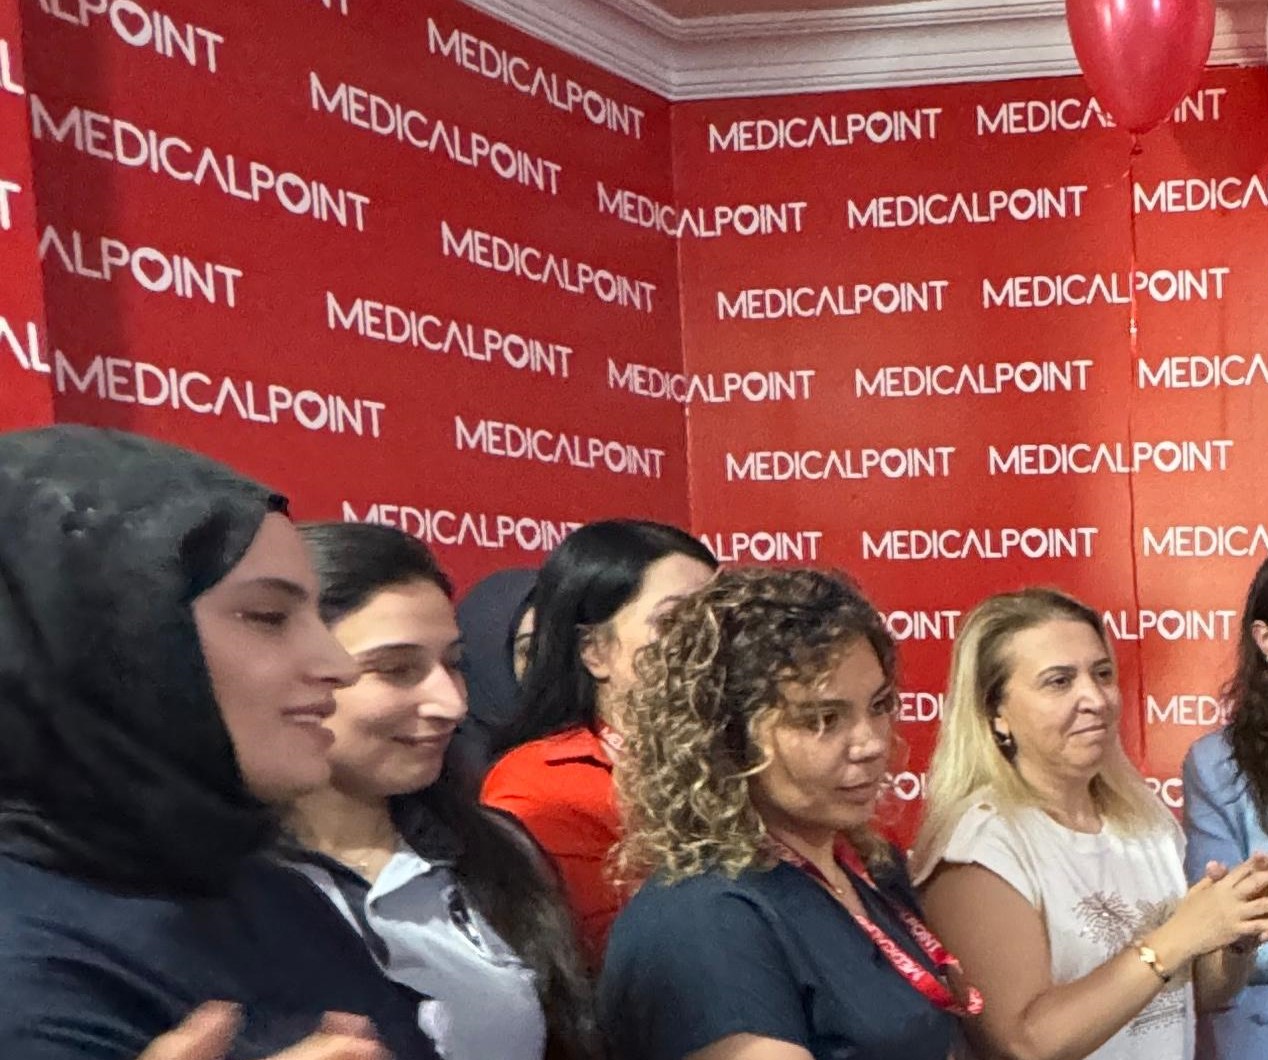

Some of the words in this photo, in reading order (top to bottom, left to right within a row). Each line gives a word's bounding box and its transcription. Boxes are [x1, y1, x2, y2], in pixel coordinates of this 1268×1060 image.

[427, 18, 644, 140] MEDICALPOINT
[310, 72, 561, 195] MEDICALPOINT
[709, 108, 942, 152] MEDICALPOINT
[977, 88, 1226, 135] MEDICAINT
[31, 94, 370, 232] MEDICALPOINT
[598, 182, 807, 238] MEDICALPOINT
[848, 186, 1088, 229] MEDICALPOINT
[40, 226, 243, 307] ALPOINT
[441, 222, 656, 313] MEDICALPOINT
[983, 268, 1229, 308] MEDICALPOINT
[718, 280, 949, 319] MEDICALPOINT
[327, 291, 573, 377] MEDICALPOINT
[55, 350, 385, 438] MEDICALPOINT
[608, 358, 815, 403] MEDICALPOINT
[856, 360, 1093, 397] MEDICALPOINT
[455, 416, 665, 478] MEDICALPOINT
[726, 447, 955, 481] MEDICALPOINT
[989, 440, 1233, 475] MEDICALPOINT
[700, 532, 822, 561] ALPOINT
[863, 528, 1098, 559] MEDICALPOINT
[1103, 610, 1236, 640] ALPOINT
